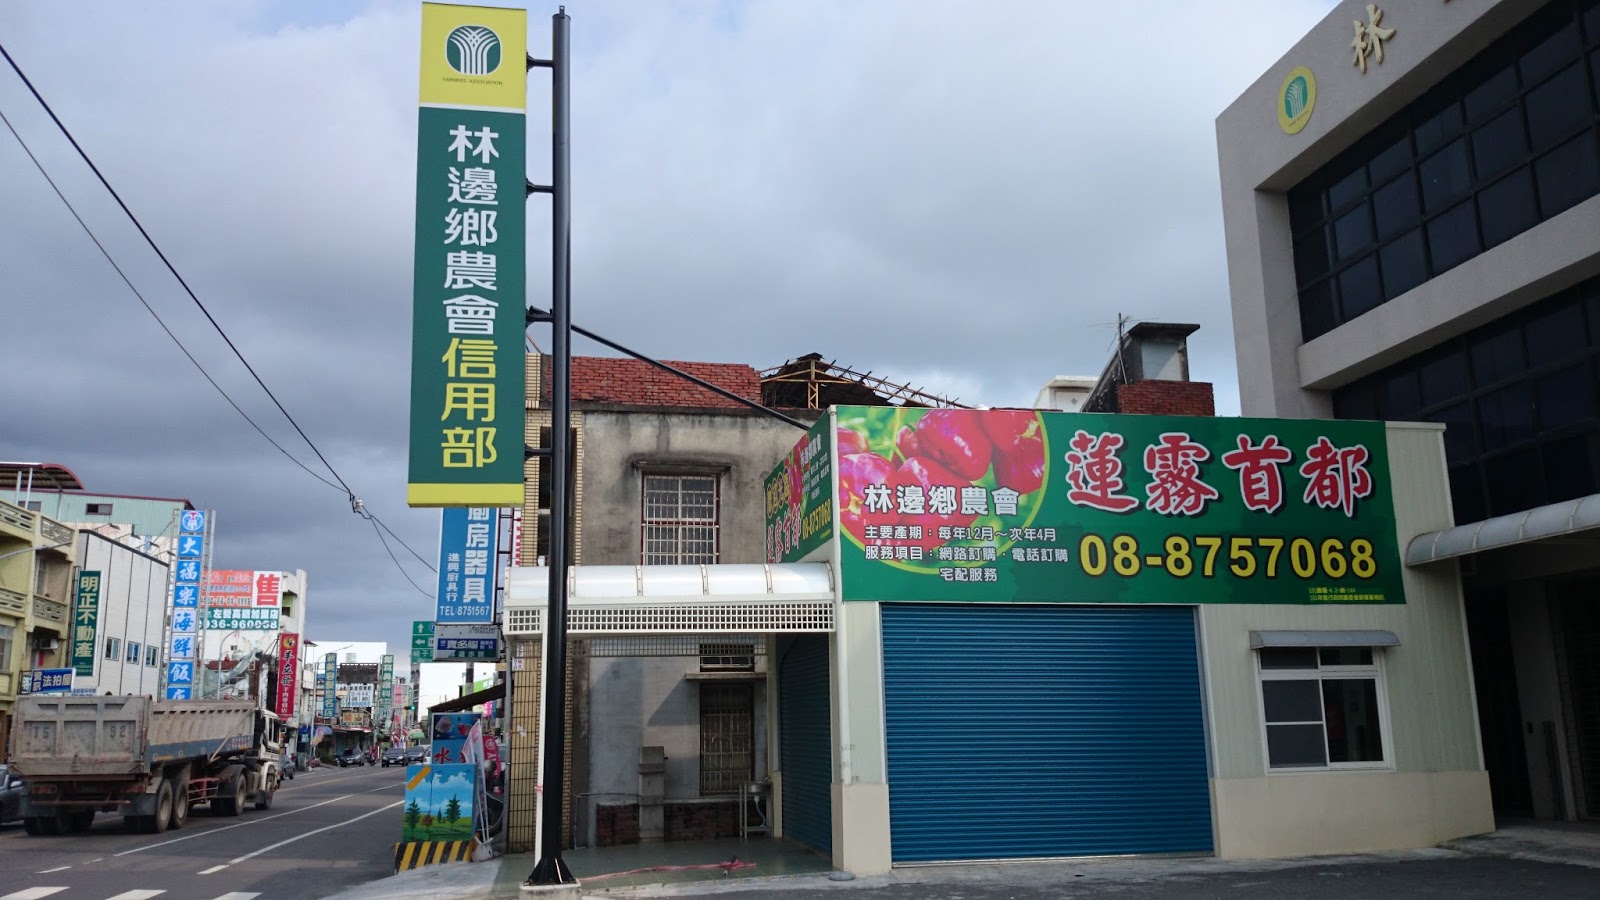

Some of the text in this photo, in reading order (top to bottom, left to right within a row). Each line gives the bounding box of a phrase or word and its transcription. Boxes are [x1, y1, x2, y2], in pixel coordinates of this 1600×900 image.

[1351, 4, 1397, 74] 林
[441, 125, 500, 468] 林邊鄉農會信用部
[864, 484, 1020, 516] 林邊鄉農會
[1065, 429, 1372, 517] 蓮霧首都
[940, 568, 998, 581] 宅配服務
[1079, 533, 1378, 579] 08-8757068
[75, 576, 99, 658] 明正不動產
[256, 573, 281, 606] 售
